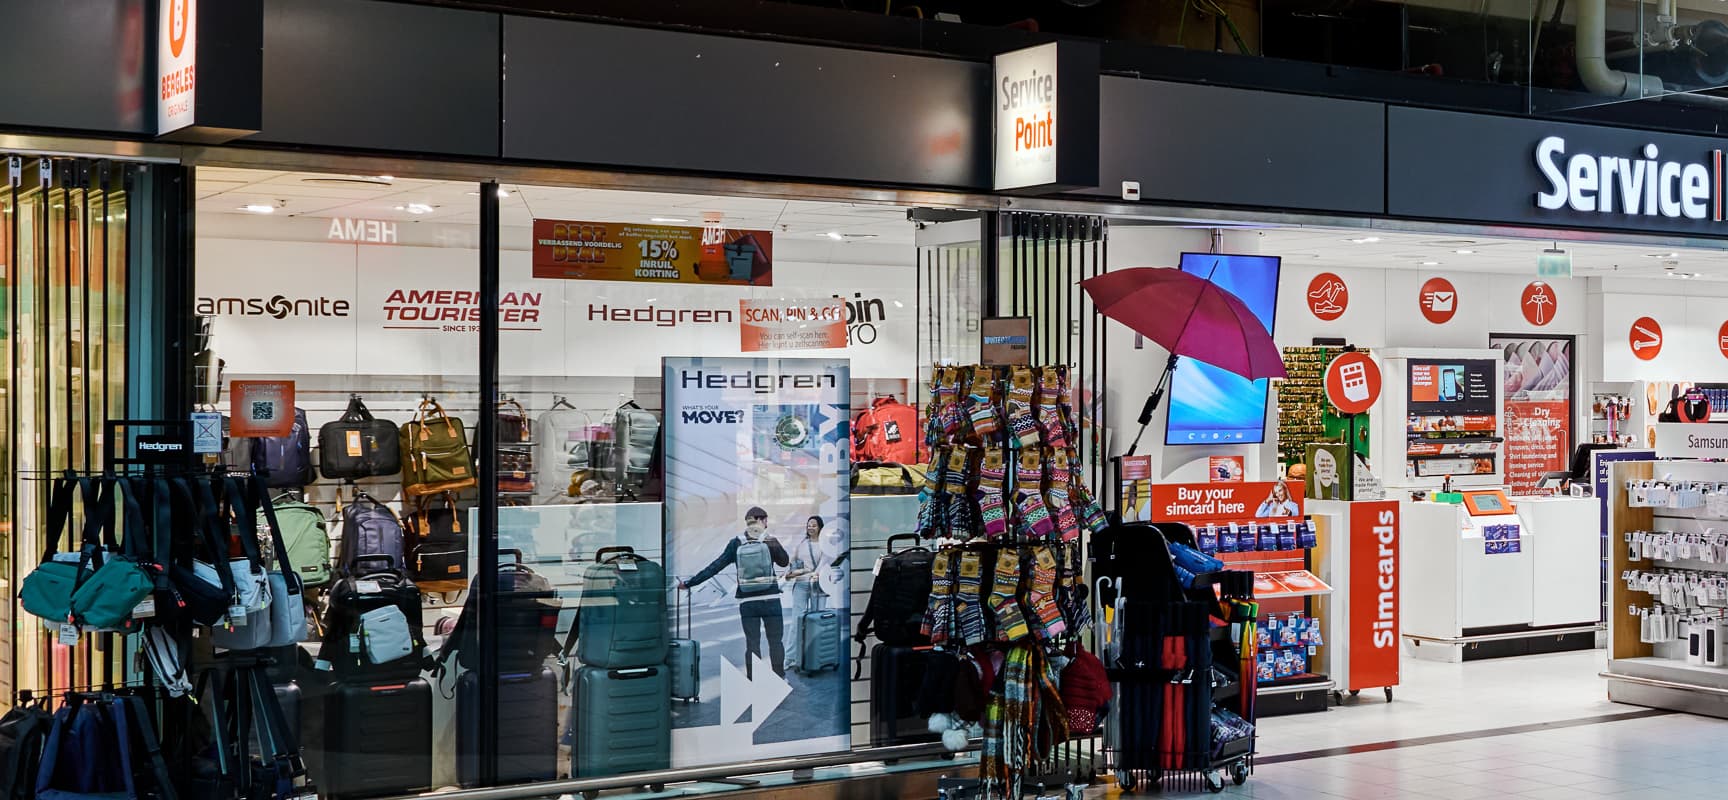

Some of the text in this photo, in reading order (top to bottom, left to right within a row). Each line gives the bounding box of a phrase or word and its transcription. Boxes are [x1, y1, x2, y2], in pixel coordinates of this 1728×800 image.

[161, 65, 194, 100] BEAGLES
[1002, 69, 1053, 111] Service
[1016, 110, 1053, 152] Point
[1535, 136, 1710, 219] Service
[538, 239, 622, 249] VERRASSEND VOORDELIG
[637, 239, 678, 260] 15%
[640, 260, 674, 270] INRUIL
[634, 269, 680, 279] KORTING
[385, 289, 542, 306] AMERIAN
[196, 294, 350, 320] amsonite
[383, 306, 541, 323] TOURISER
[745, 308, 783, 323] SCAN,
[786, 308, 806, 321] PIN
[810, 307, 819, 320] &
[588, 304, 733, 327] Hedgren
[468, 325, 480, 333] 193
[760, 331, 772, 340] You
[681, 370, 837, 394] Hedgren
[682, 409, 745, 424] MOVE?
[1534, 407, 1551, 418] Dry
[1522, 417, 1561, 429] Cleaning
[139, 441, 183, 452] Hedgren
[1178, 487, 1234, 501] Buy your
[1166, 500, 1245, 516] simcard here
[1372, 509, 1395, 649] Simcards
